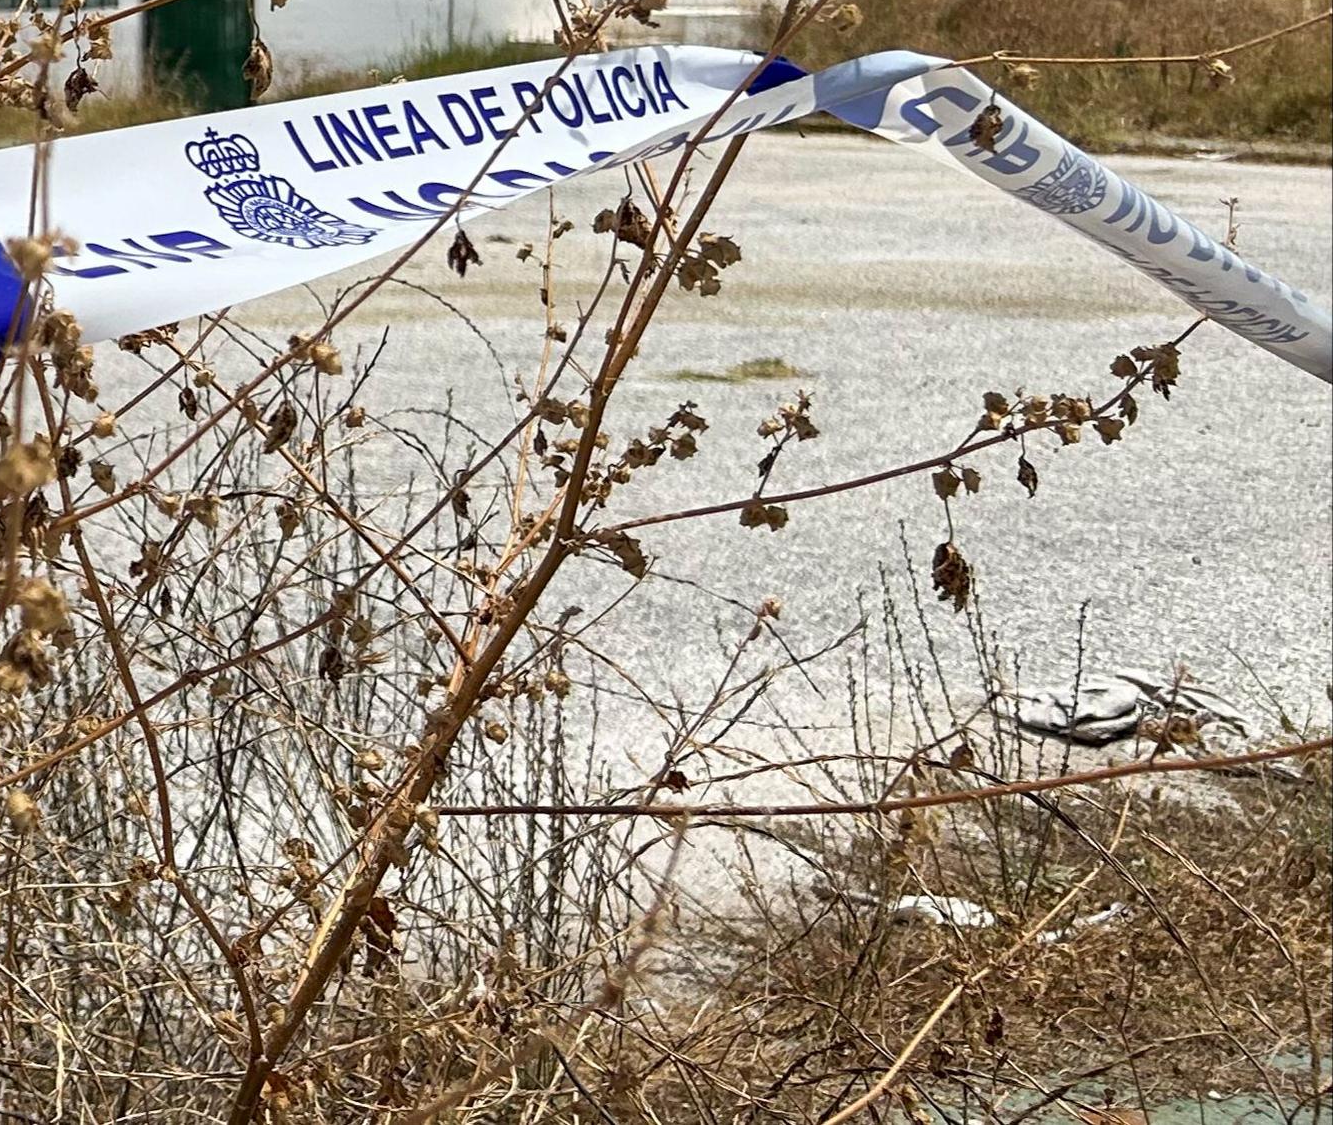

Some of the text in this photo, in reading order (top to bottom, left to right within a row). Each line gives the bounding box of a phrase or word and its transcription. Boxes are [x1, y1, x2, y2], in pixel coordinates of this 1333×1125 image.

[283, 99, 452, 173] LINEA
[437, 85, 520, 146] DE
[511, 60, 690, 135] POLICIA
